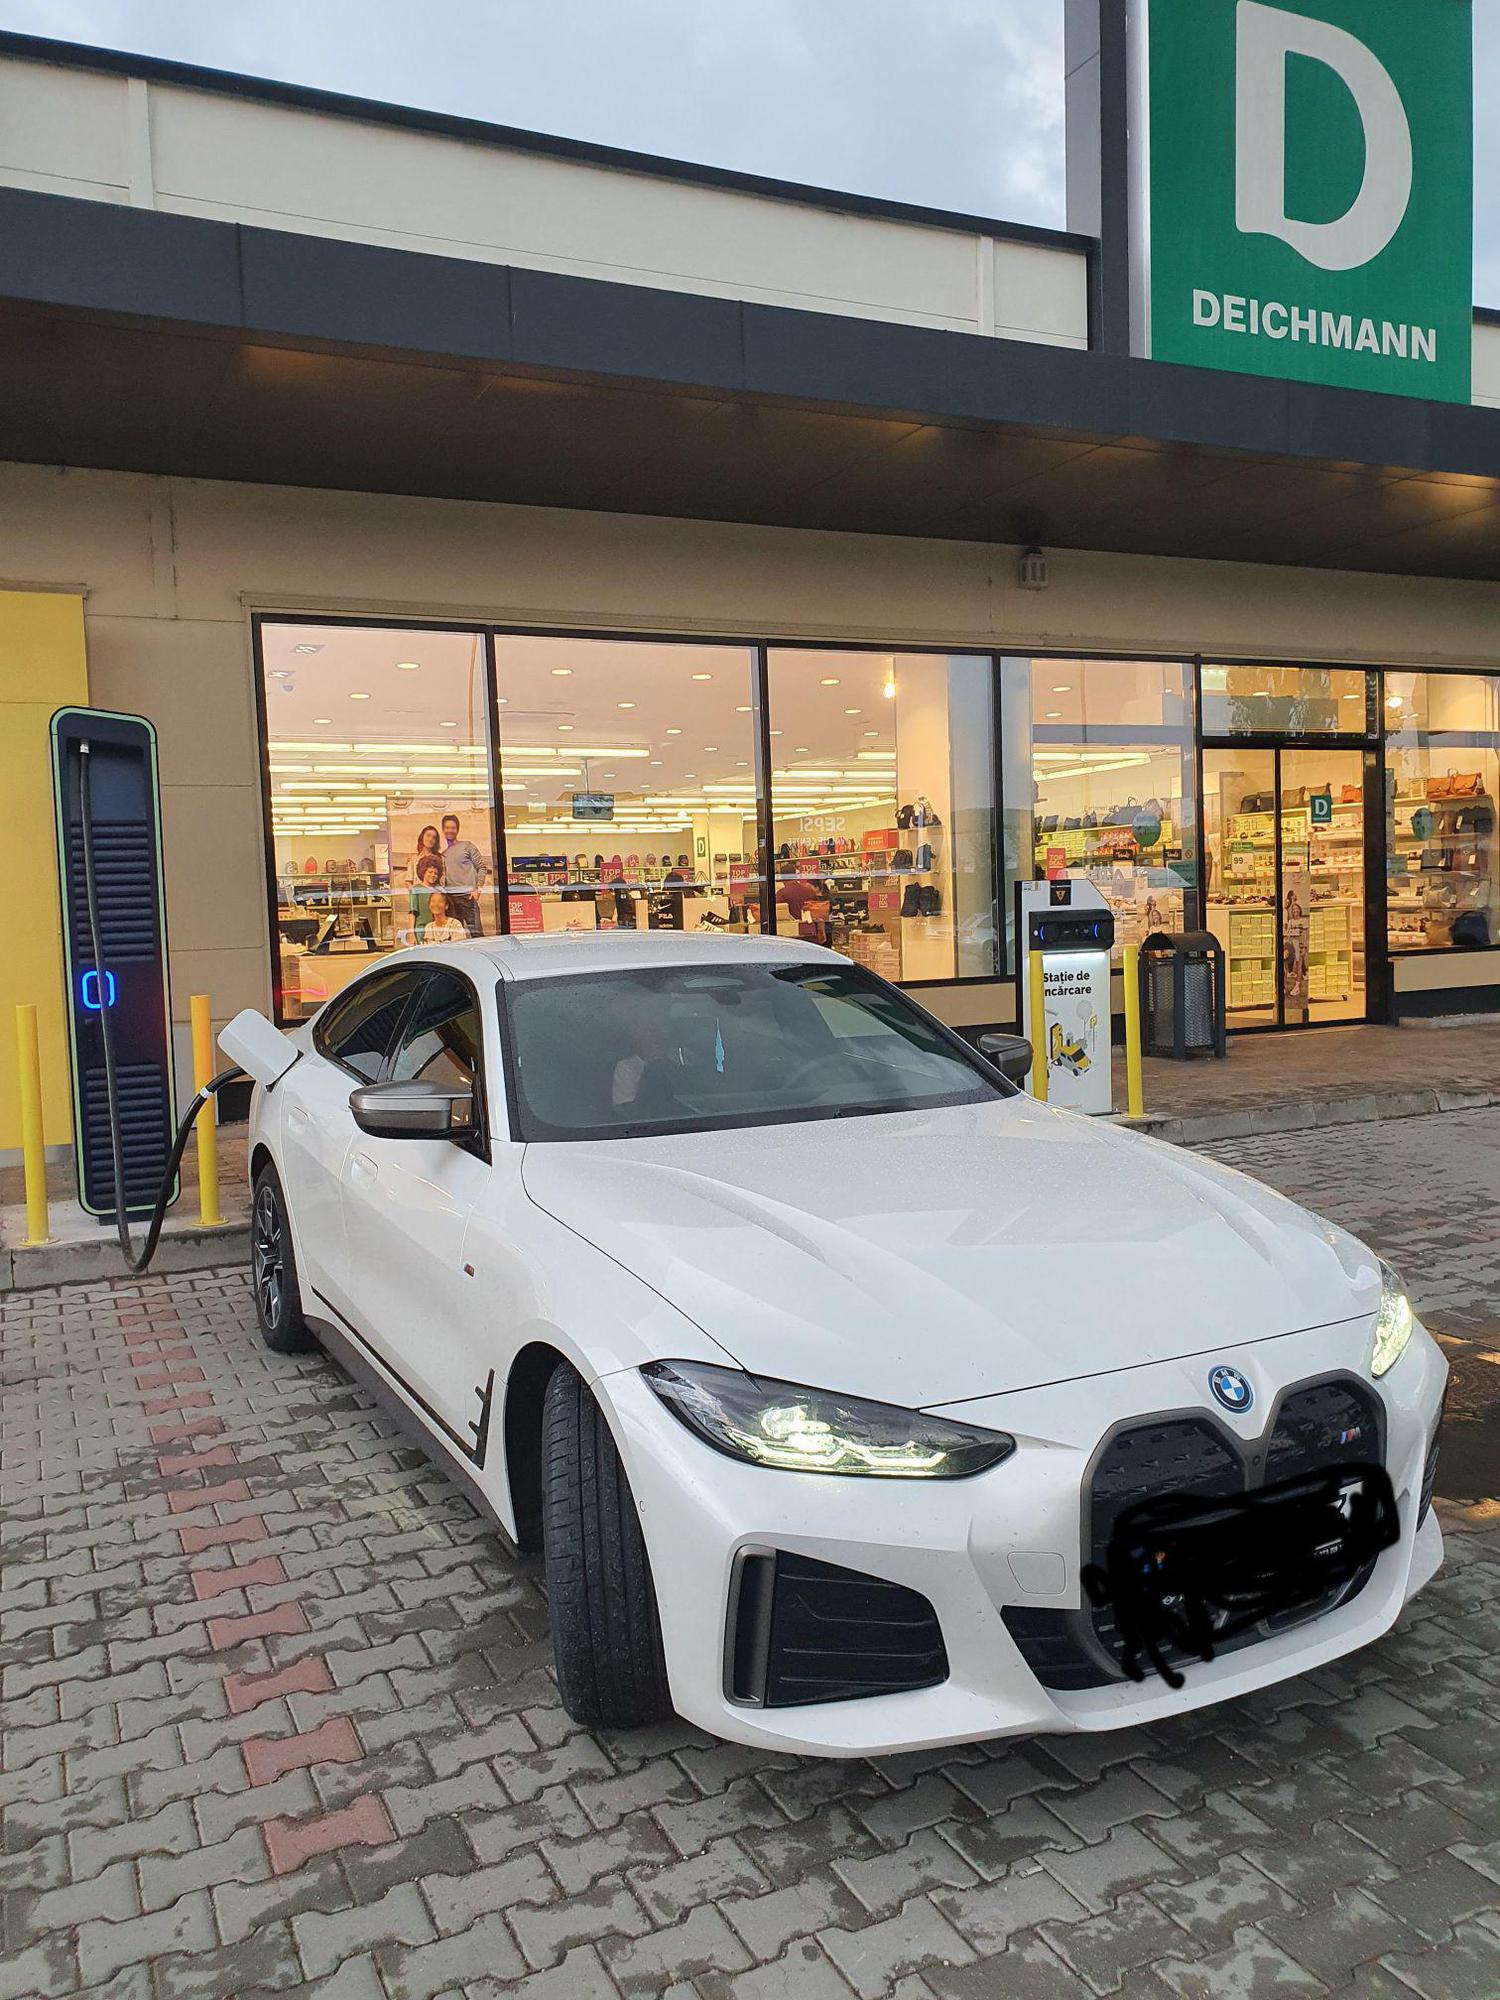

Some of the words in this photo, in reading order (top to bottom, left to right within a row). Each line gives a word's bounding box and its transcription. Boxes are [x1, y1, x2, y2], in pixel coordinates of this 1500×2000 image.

[1192, 288, 1437, 362] DEICHMANN
[1043, 971, 1074, 984] Stație
[1076, 970, 1090, 981] de
[1044, 985, 1092, 997] ncărcare
